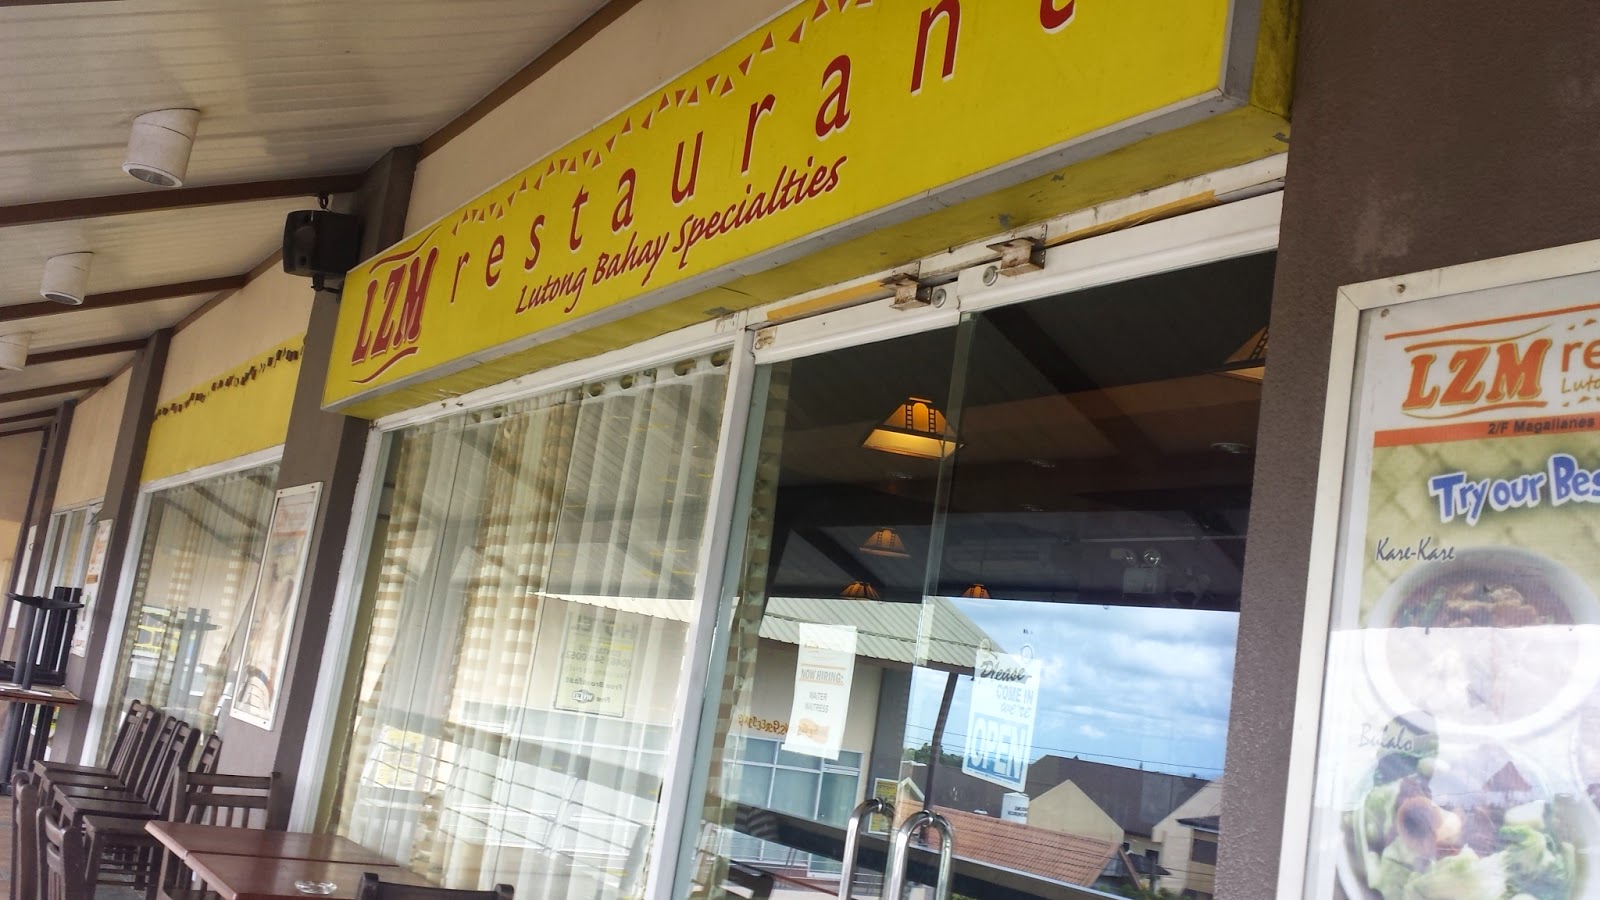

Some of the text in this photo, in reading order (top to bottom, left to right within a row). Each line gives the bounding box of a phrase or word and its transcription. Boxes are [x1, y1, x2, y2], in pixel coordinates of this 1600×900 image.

[515, 156, 847, 314] Lutong Bahay Specialties
[352, 247, 438, 364] LZM
[1402, 338, 1553, 411] LZM
[1488, 417, 1595, 435] 2/F Magallanes
[1430, 472, 1489, 523] Try
[1491, 473, 1546, 509] our
[1376, 537, 1455, 561] Kare-Kare
[801, 668, 816, 680] NOW
[980, 660, 1032, 682] Please
[809, 691, 828, 701] WAITER
[996, 684, 1034, 706] COME IN
[804, 702, 829, 713] WAITRESS
[970, 717, 1028, 780] OPEN
